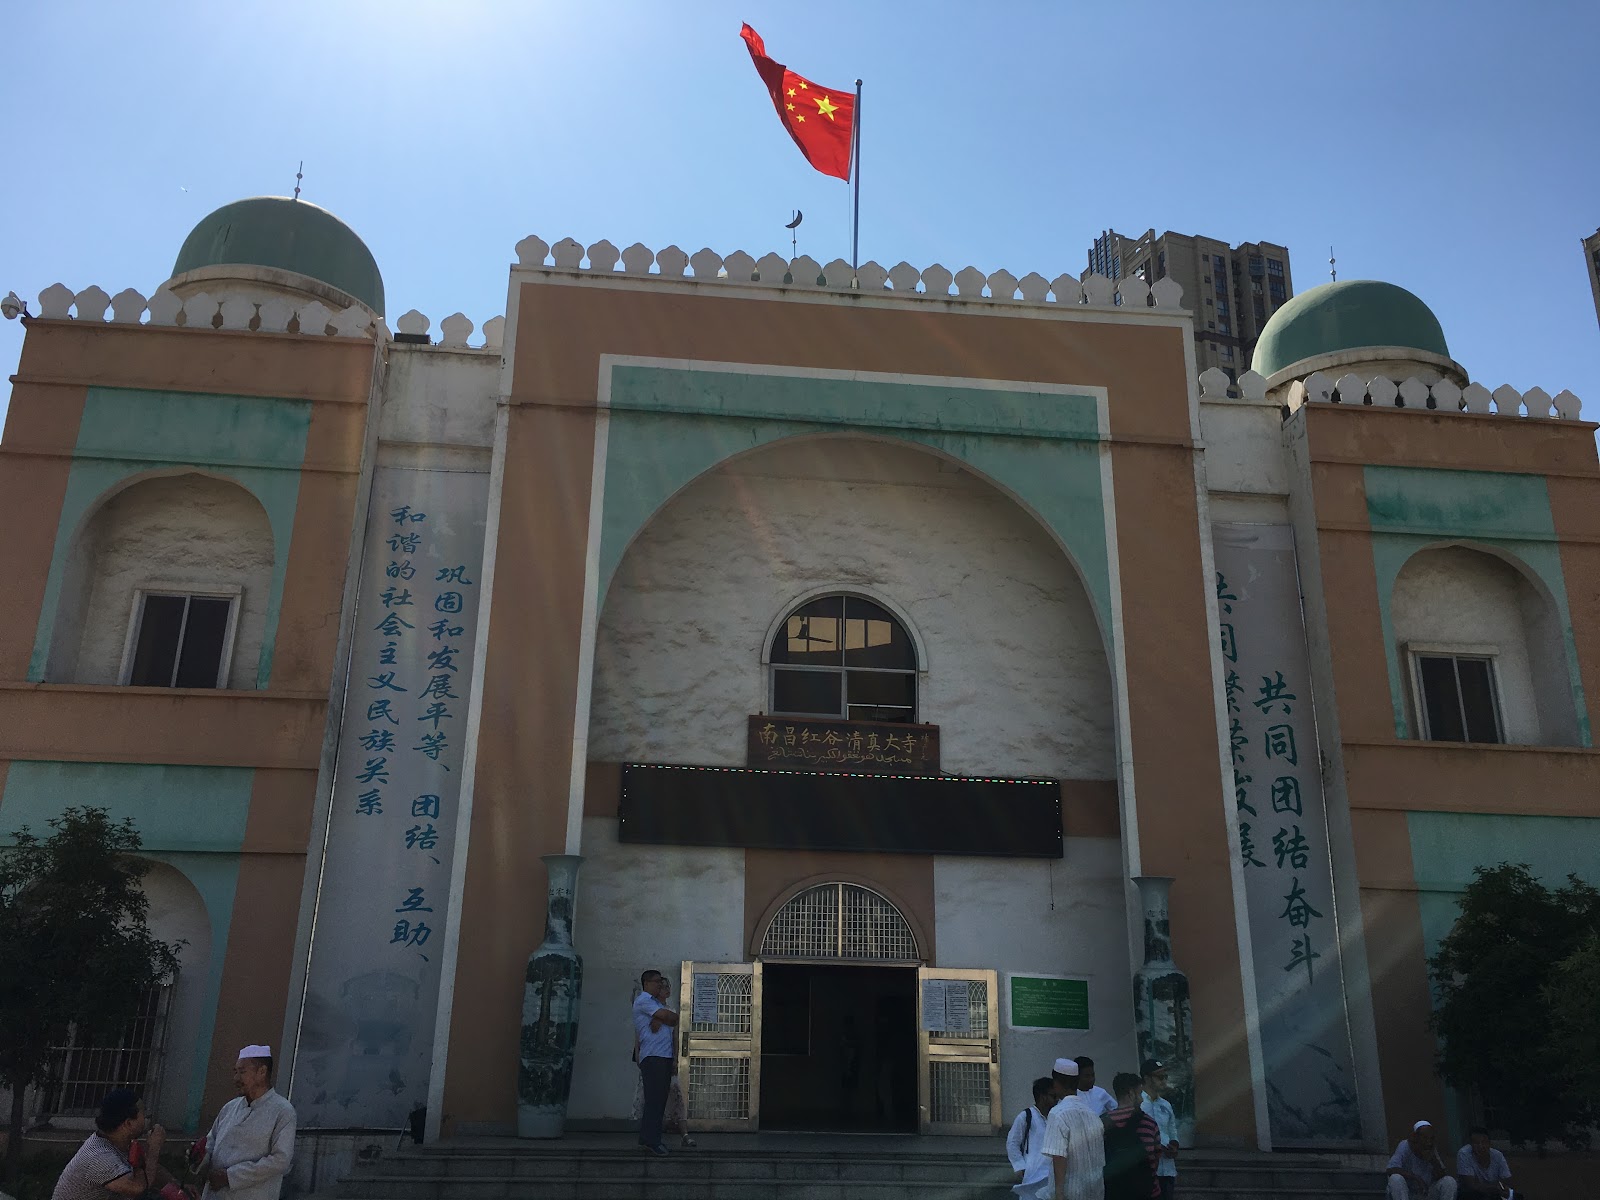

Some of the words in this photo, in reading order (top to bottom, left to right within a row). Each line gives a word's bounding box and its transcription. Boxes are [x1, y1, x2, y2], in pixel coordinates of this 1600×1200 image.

[355, 505, 427, 816] 和谐的社会主义民族关系
[759, 722, 917, 754] 南昌红谷清真大寺
[875, 754, 912, 766] مسجد
[1252, 671, 1323, 985] 共同团结奋斗
